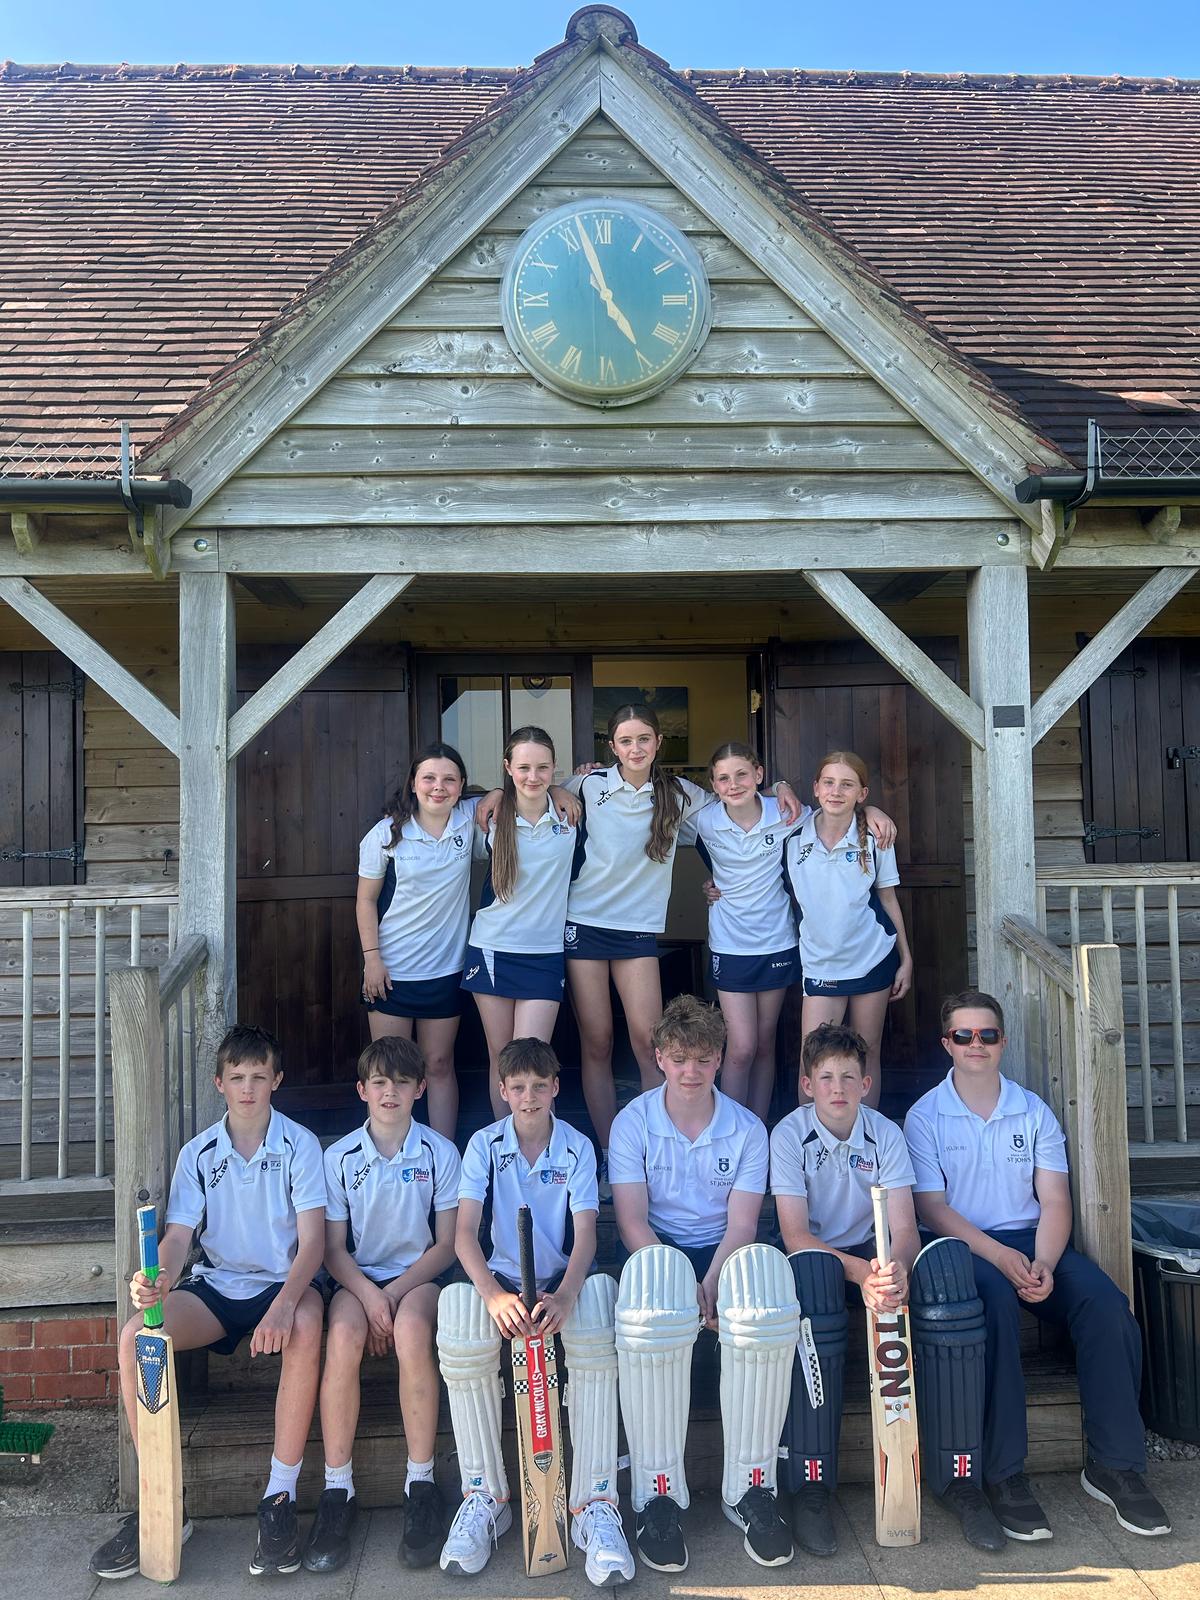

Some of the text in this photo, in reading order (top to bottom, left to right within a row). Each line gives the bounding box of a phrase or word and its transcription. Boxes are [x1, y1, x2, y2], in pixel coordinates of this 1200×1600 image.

[595, 217, 612, 245] XII
[530, 253, 558, 278] X
[523, 291, 549, 307] IX
[662, 294, 688, 306] III
[600, 356, 617, 381] VI
[875, 1313, 911, 1397] TON
